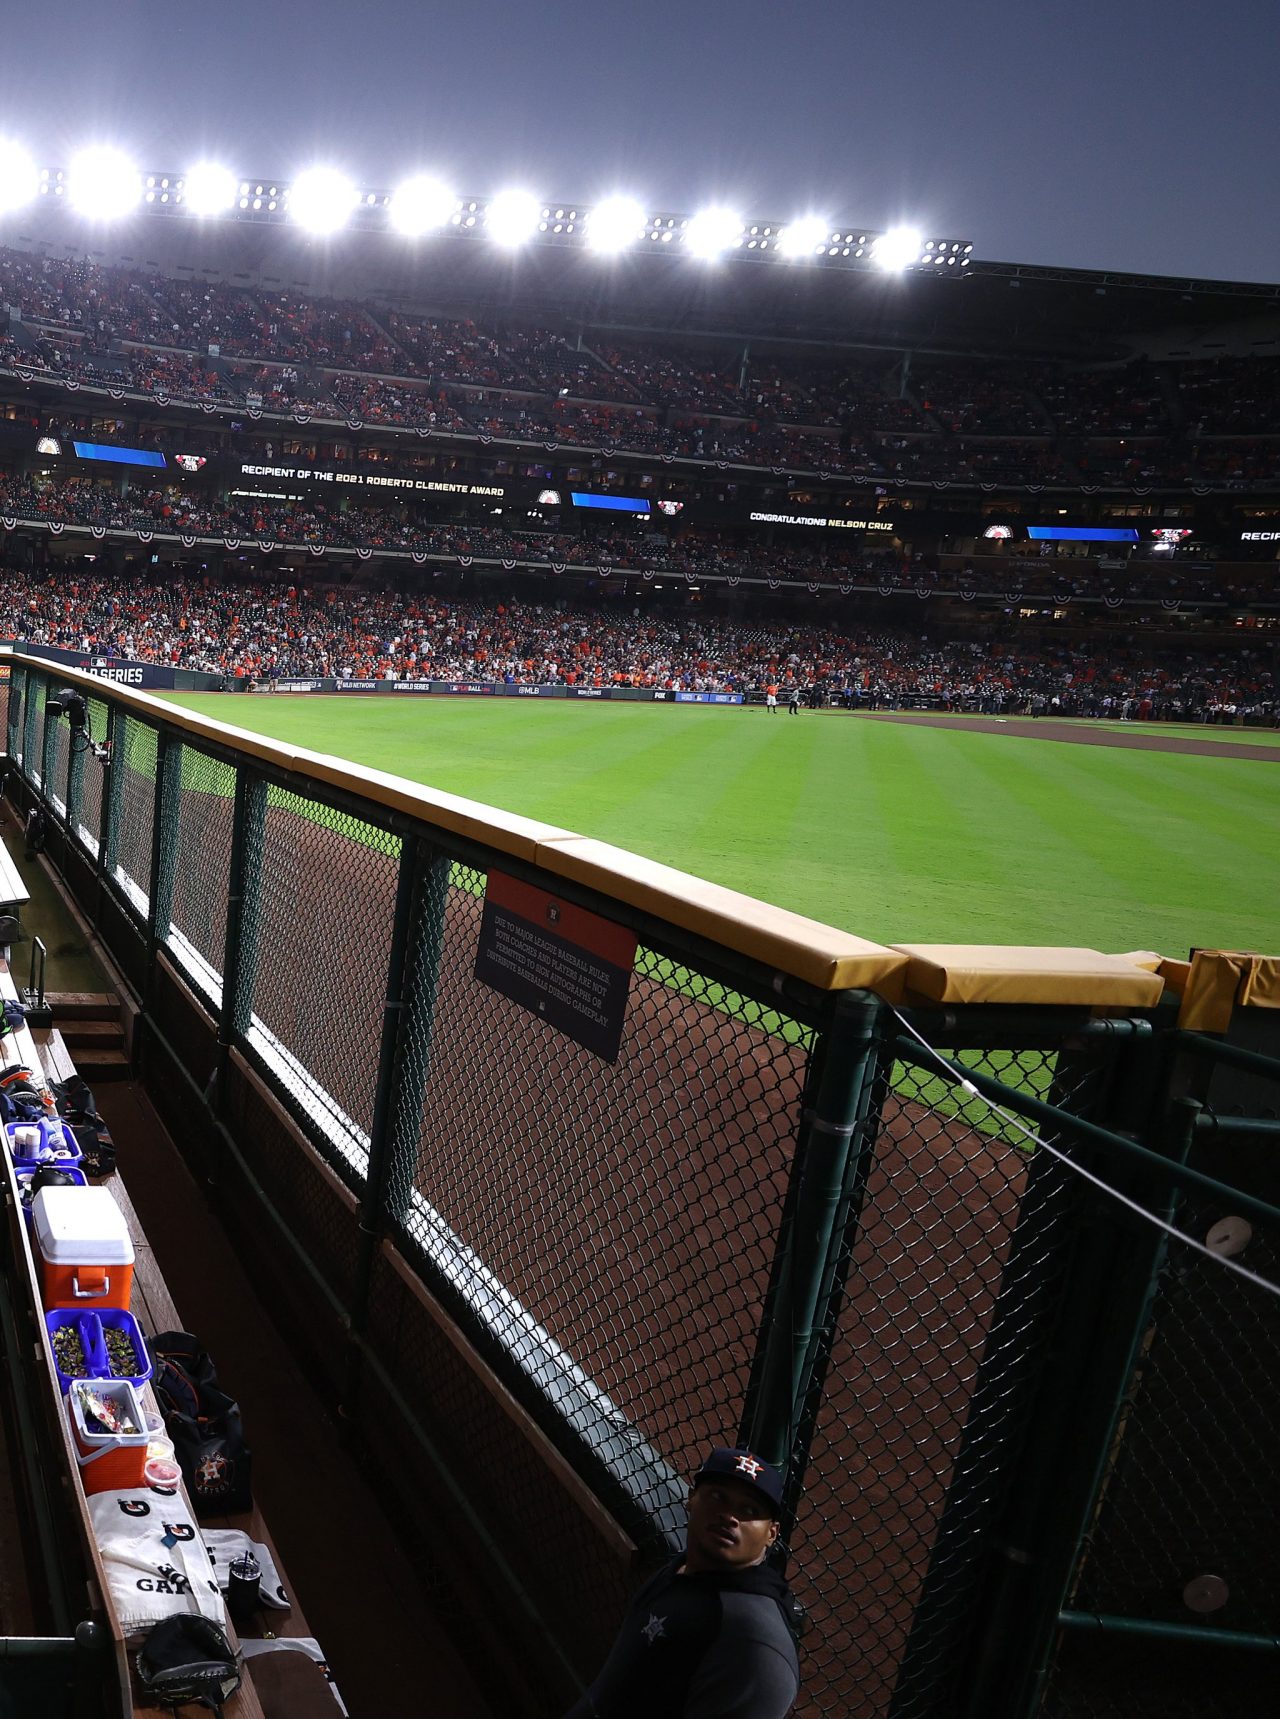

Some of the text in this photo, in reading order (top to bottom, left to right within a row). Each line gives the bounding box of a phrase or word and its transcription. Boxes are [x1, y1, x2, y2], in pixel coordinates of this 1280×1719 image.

[241, 464, 505, 497] RECIPIENT OF THE 2021 ROBERTO CLEMENTE AWARD
[750, 512, 893, 531] CONGRATULATIONS NELSON CRUZ
[100, 668, 143, 684] SERIES
[413, 683, 429, 691] SERIES
[495, 916, 506, 928] DUE
[507, 921, 514, 931] TO
[515, 925, 533, 942] MAJOR
[534, 937, 557, 955] LEAGUE
[558, 949, 588, 972] BASEBALL
[496, 928, 607, 997] BOTH COACHES AND PLAYERS ARE NOT
[487, 949, 517, 972] DISTRIBUTE
[517, 966, 548, 991] BASEBALLS
[548, 985, 571, 1004] DURING
[496, 942, 525, 964] PERMITTED
[527, 959, 535, 969] TO
[550, 973, 591, 1002] AUTOGRAPHS
[592, 997, 602, 1009] OR
